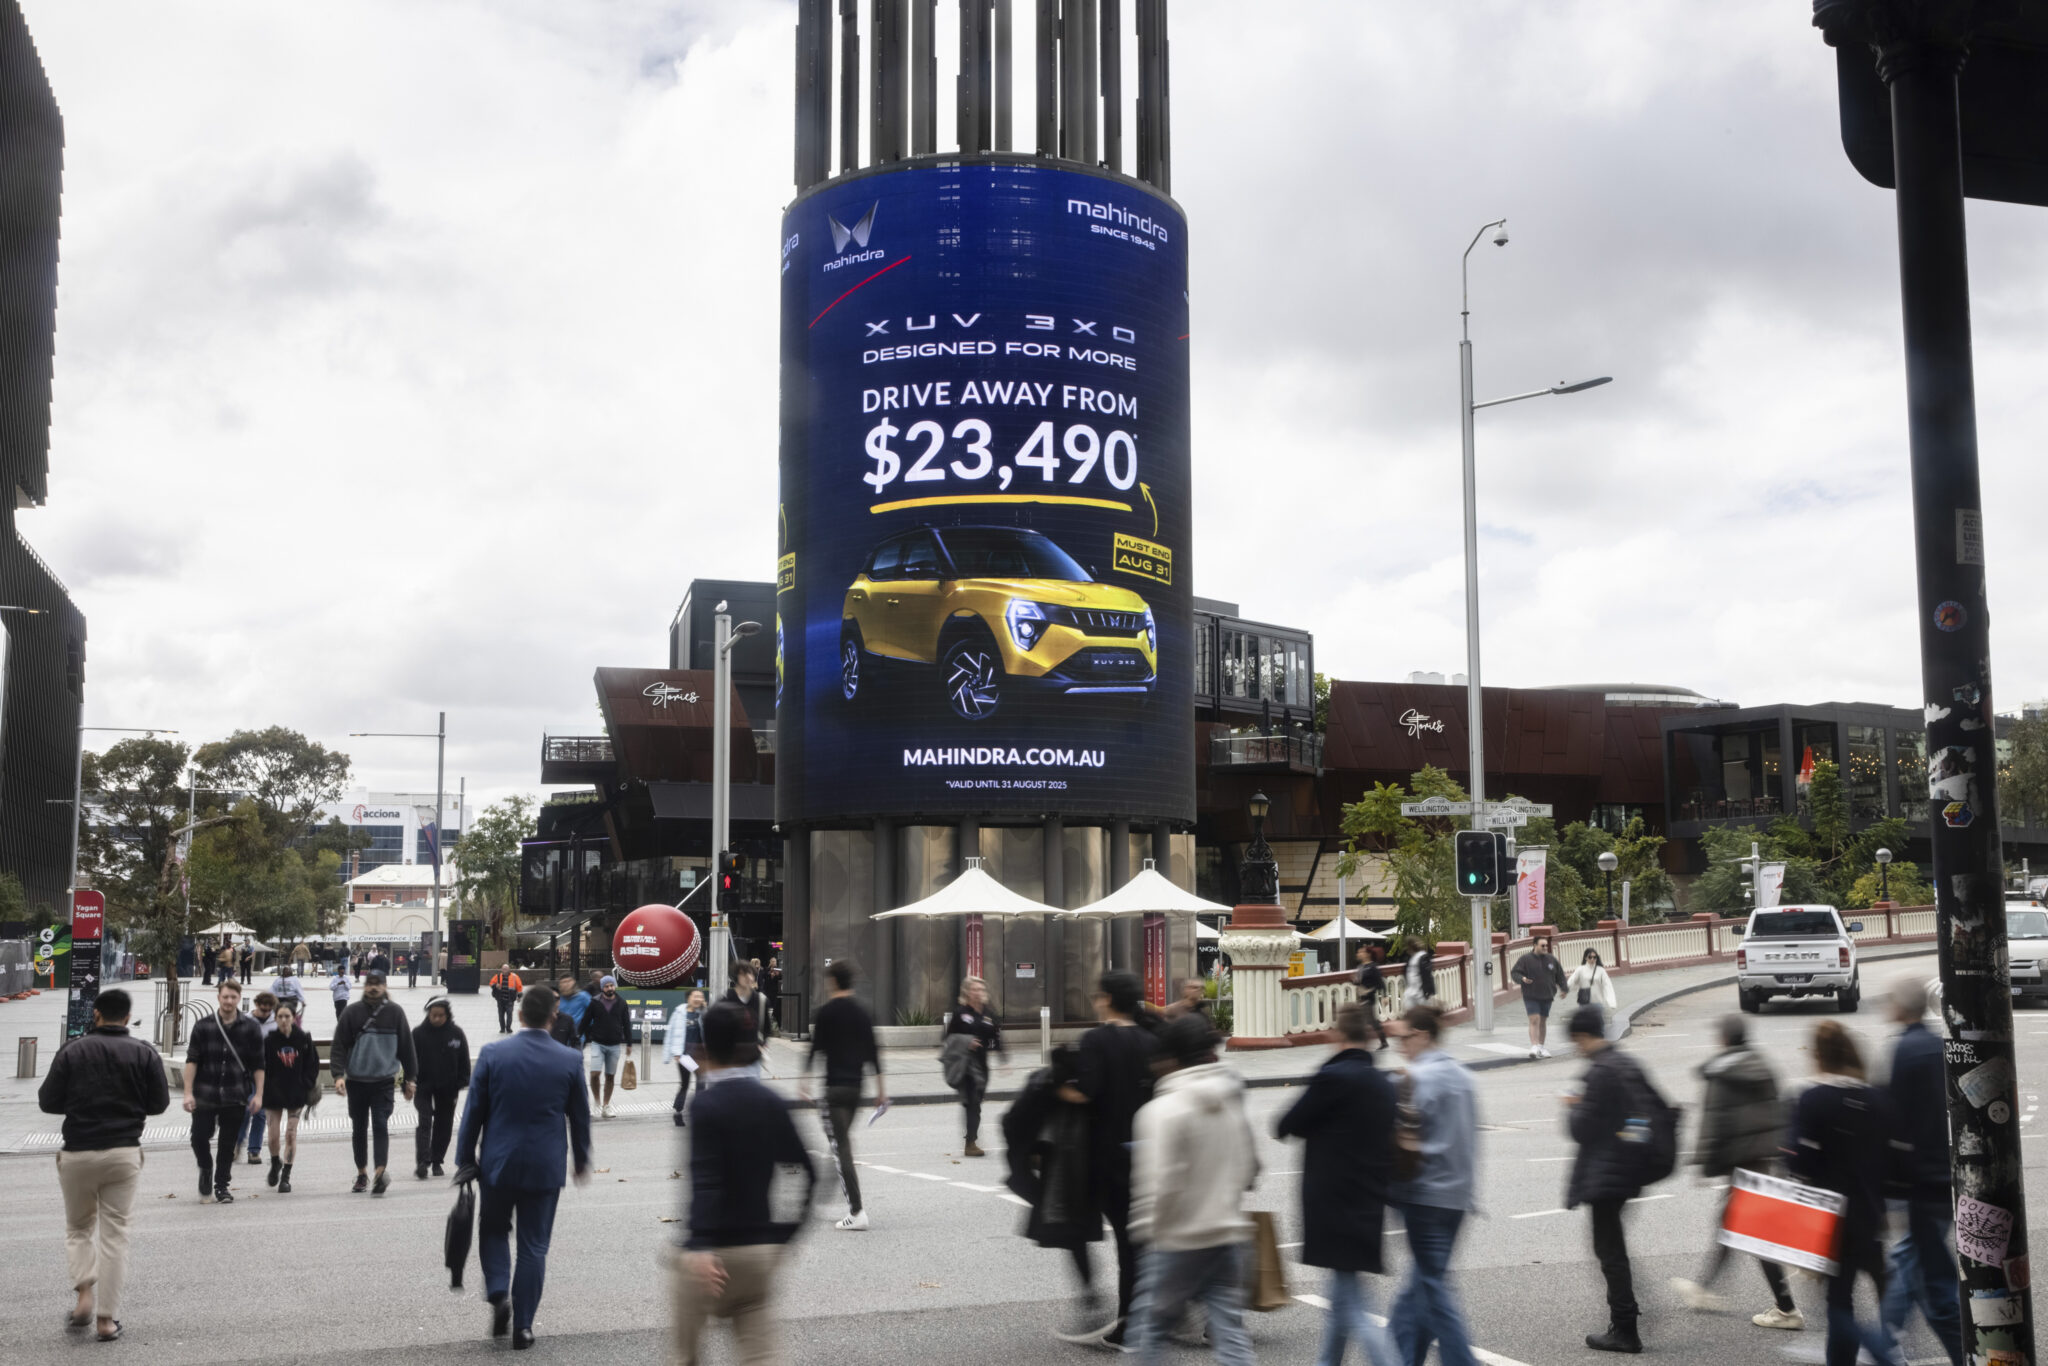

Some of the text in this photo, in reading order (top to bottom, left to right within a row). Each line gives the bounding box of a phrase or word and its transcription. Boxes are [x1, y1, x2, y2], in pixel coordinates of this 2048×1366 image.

[1067, 199, 1168, 243] mahindra
[1090, 224, 1156, 251] SINCE 1945
[823, 249, 885, 273] mahindra
[865, 313, 981, 337] XUV
[863, 341, 1137, 371] DESIGNED FOR MORE
[863, 380, 1137, 420] DRIVE AWAY FROM
[1117, 537, 1170, 560] MUST END
[1118, 554, 1169, 577] AUG 31
[642, 681, 701, 709] Stories
[1398, 708, 1446, 740] Stories
[903, 747, 1106, 768] MAHINDRA.COM.AU
[975, 780, 1001, 789] UNTIL
[1001, 780, 1012, 789] 31
[1012, 780, 1047, 789] AUGUST
[1048, 780, 1068, 790] 2025
[362, 808, 400, 818] acciona
[1408, 804, 1450, 813] WELLINGTON
[1491, 815, 1518, 825] WILLIAM
[1528, 880, 1539, 910] KAYA
[75, 911, 101, 919] Square
[76, 904, 98, 912] Yagan
[620, 946, 660, 957] ASHES
[1764, 951, 1821, 961] RAM
[644, 1009, 662, 1019] 33
[1960, 1199, 2011, 1222] DOLFIN
[1958, 1243, 1995, 1265] OVE
